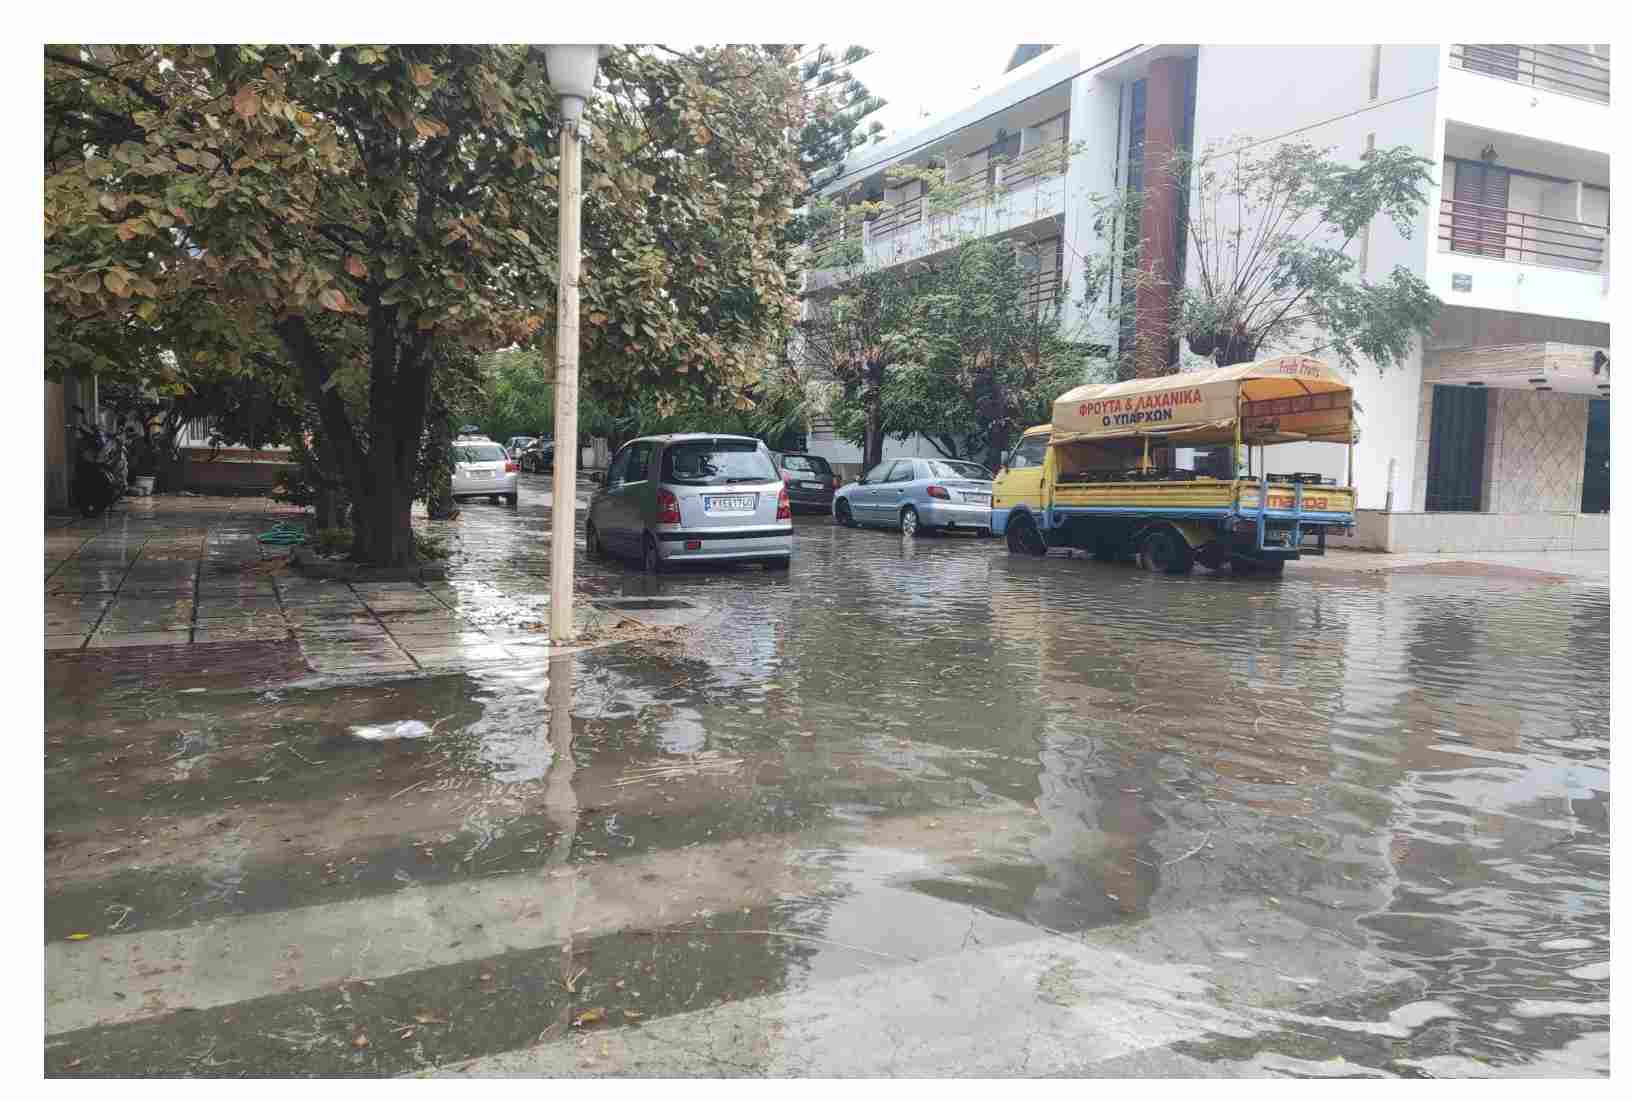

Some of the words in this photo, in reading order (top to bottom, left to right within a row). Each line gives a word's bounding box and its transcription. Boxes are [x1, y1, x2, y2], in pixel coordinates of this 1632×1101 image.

[1079, 400, 1121, 416] ΦΡΟΥΤΑ
[1134, 388, 1202, 410] ΛΑΧΑΝΙΚΑ
[1114, 408, 1172, 425] ΥΠΑΡΧΩΝ
